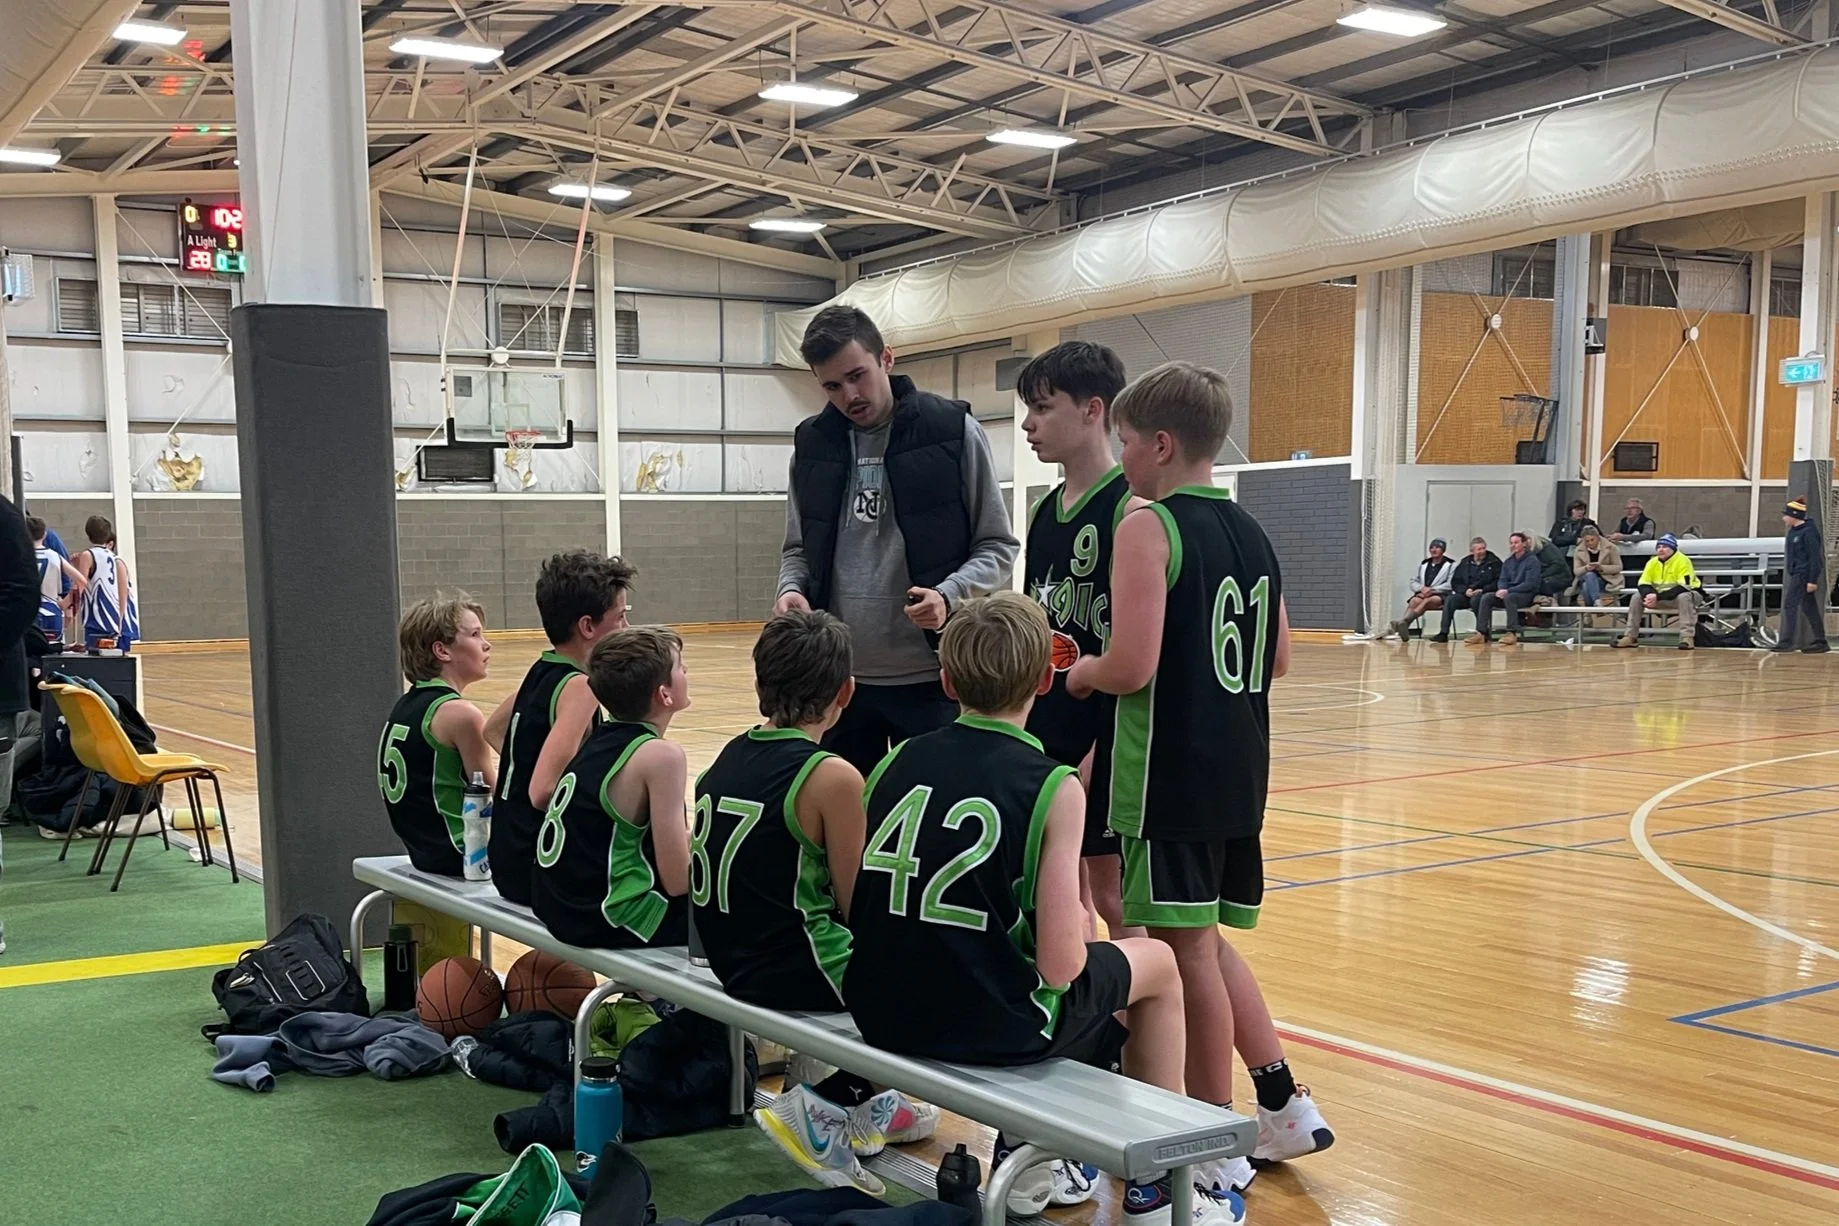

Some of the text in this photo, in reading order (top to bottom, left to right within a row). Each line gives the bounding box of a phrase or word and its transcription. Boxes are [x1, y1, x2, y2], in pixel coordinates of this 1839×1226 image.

[187, 234, 217, 250] A Light
[214, 208, 243, 229] 102
[107, 557, 115, 585] 3
[1070, 524, 1099, 577] 9
[1211, 576, 1269, 694] 61
[537, 772, 576, 868] 8
[690, 794, 764, 914] 87
[862, 784, 1002, 932] 42
